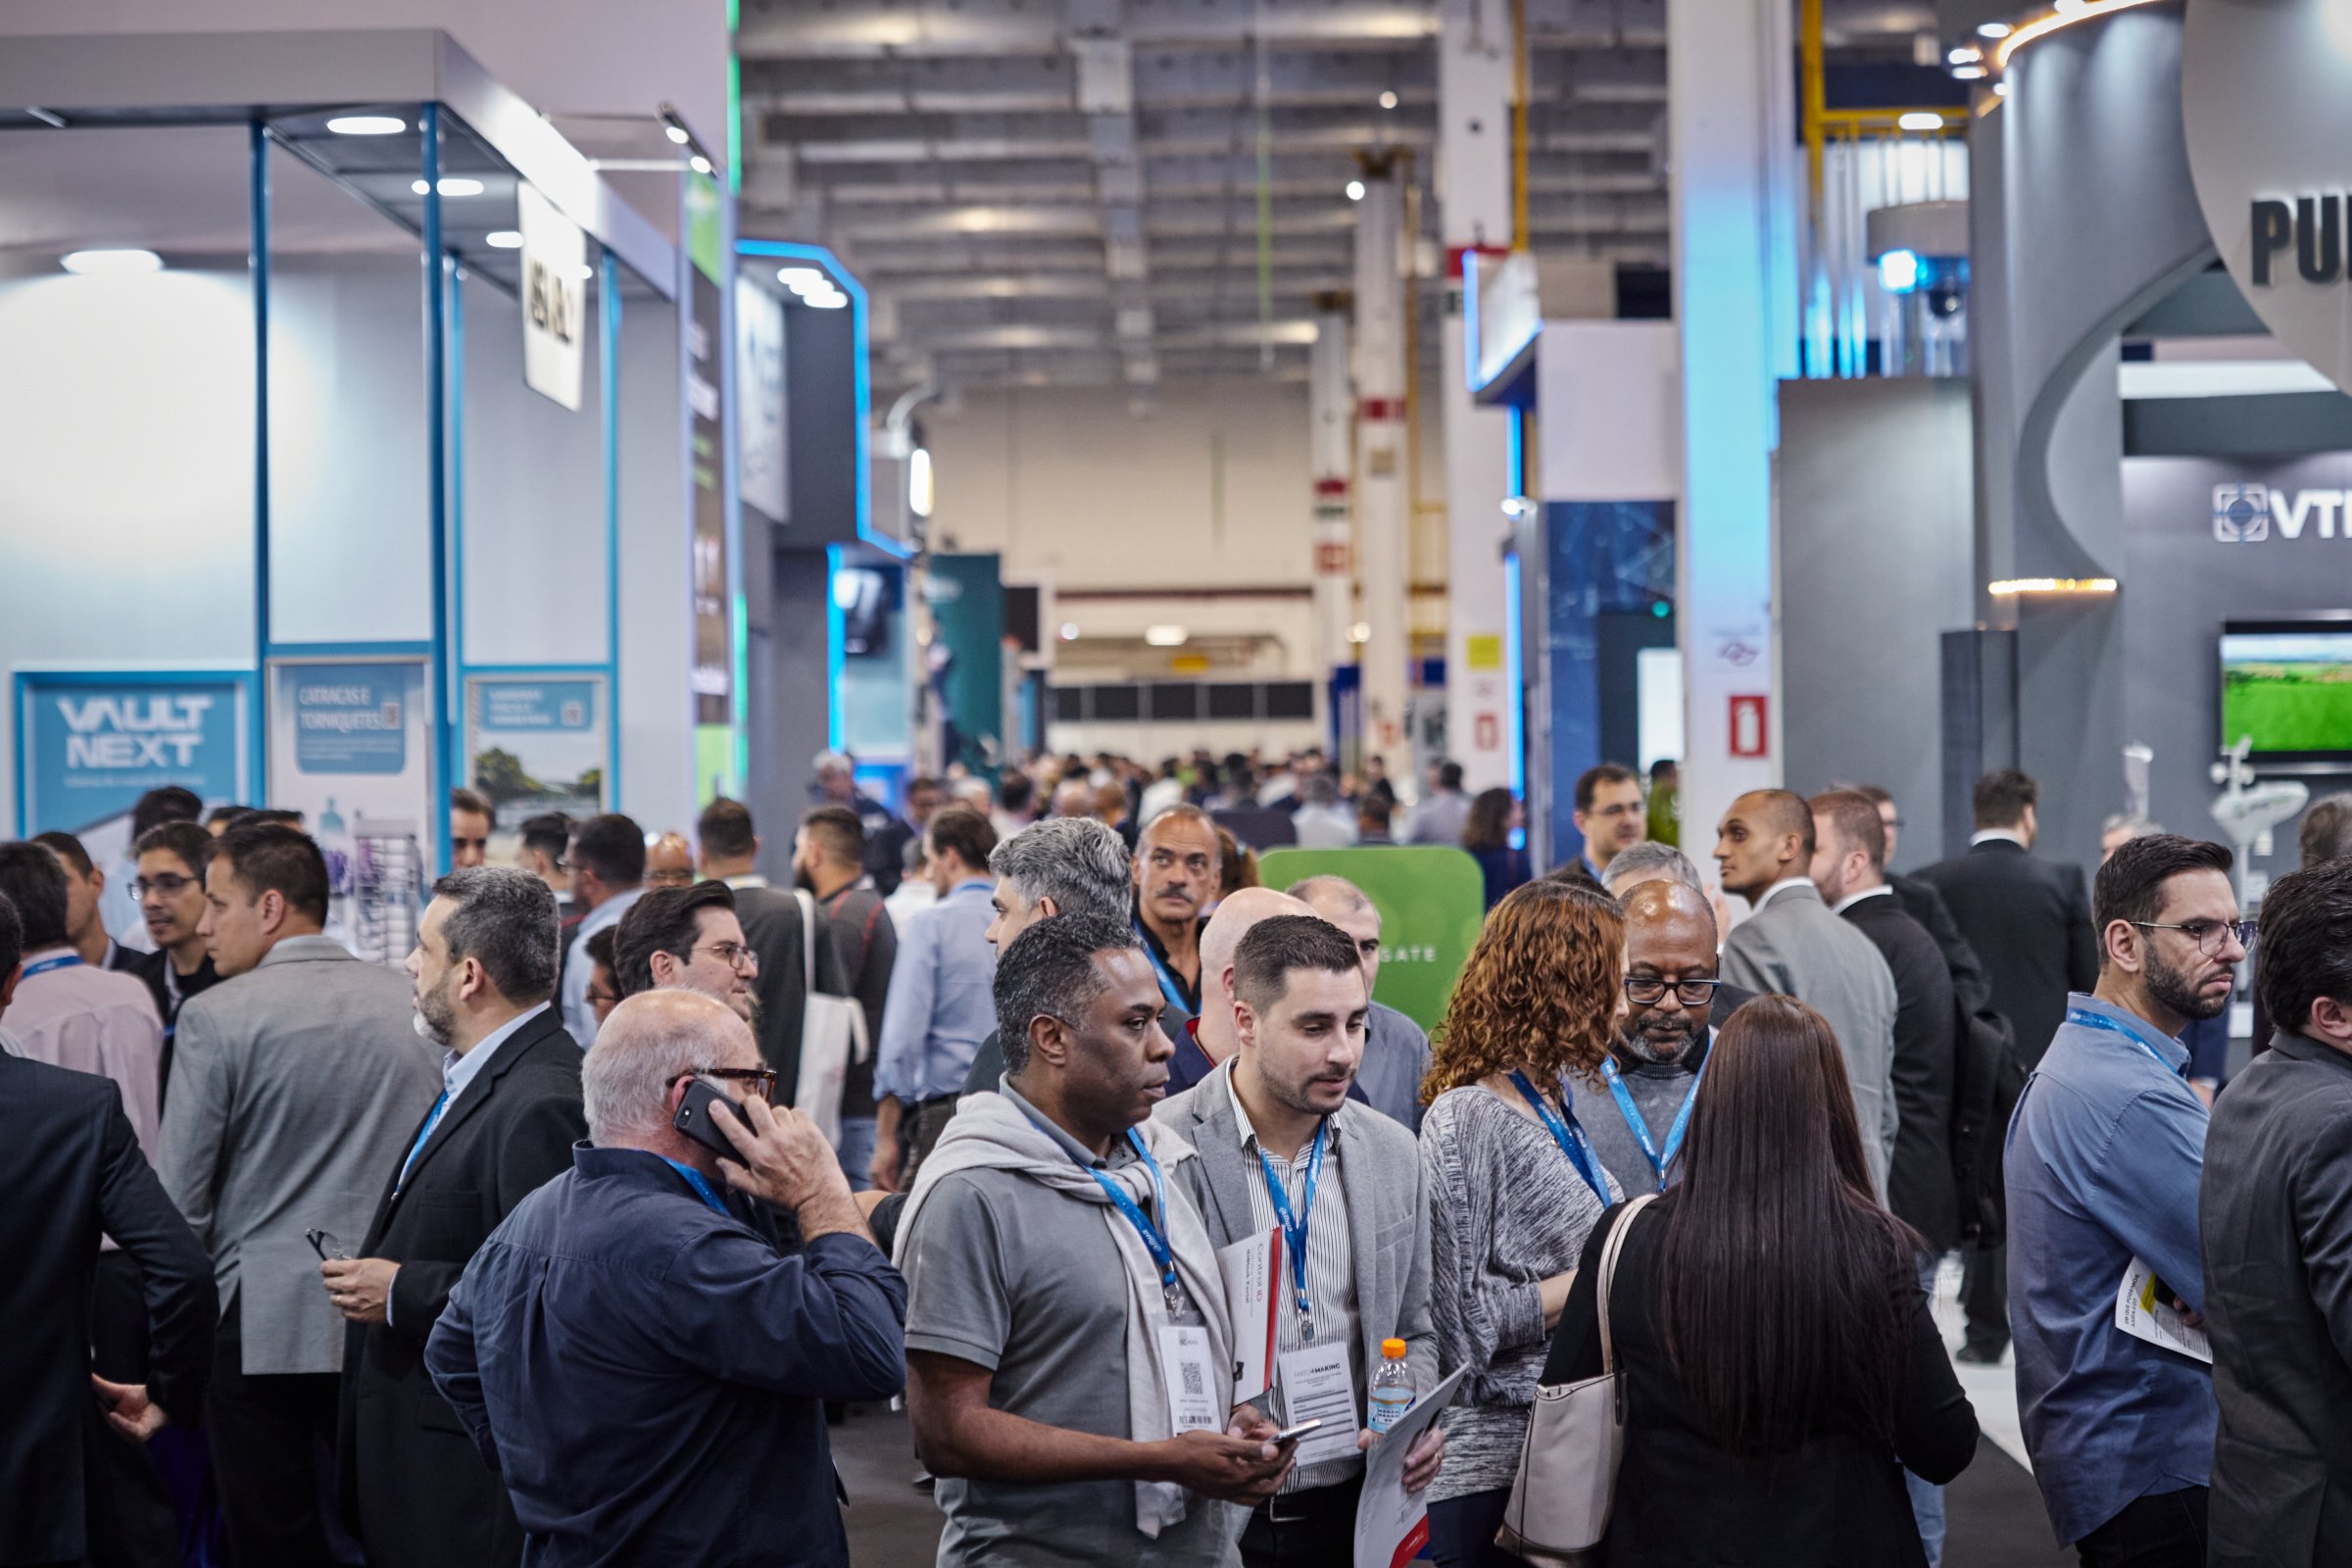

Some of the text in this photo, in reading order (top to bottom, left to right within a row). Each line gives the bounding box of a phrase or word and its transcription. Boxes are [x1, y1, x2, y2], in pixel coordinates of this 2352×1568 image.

[2251, 196, 2352, 286] PU
[56, 696, 214, 732] VAULT
[300, 711, 380, 733] TORNIQUETES
[66, 734, 204, 768] NEXT
